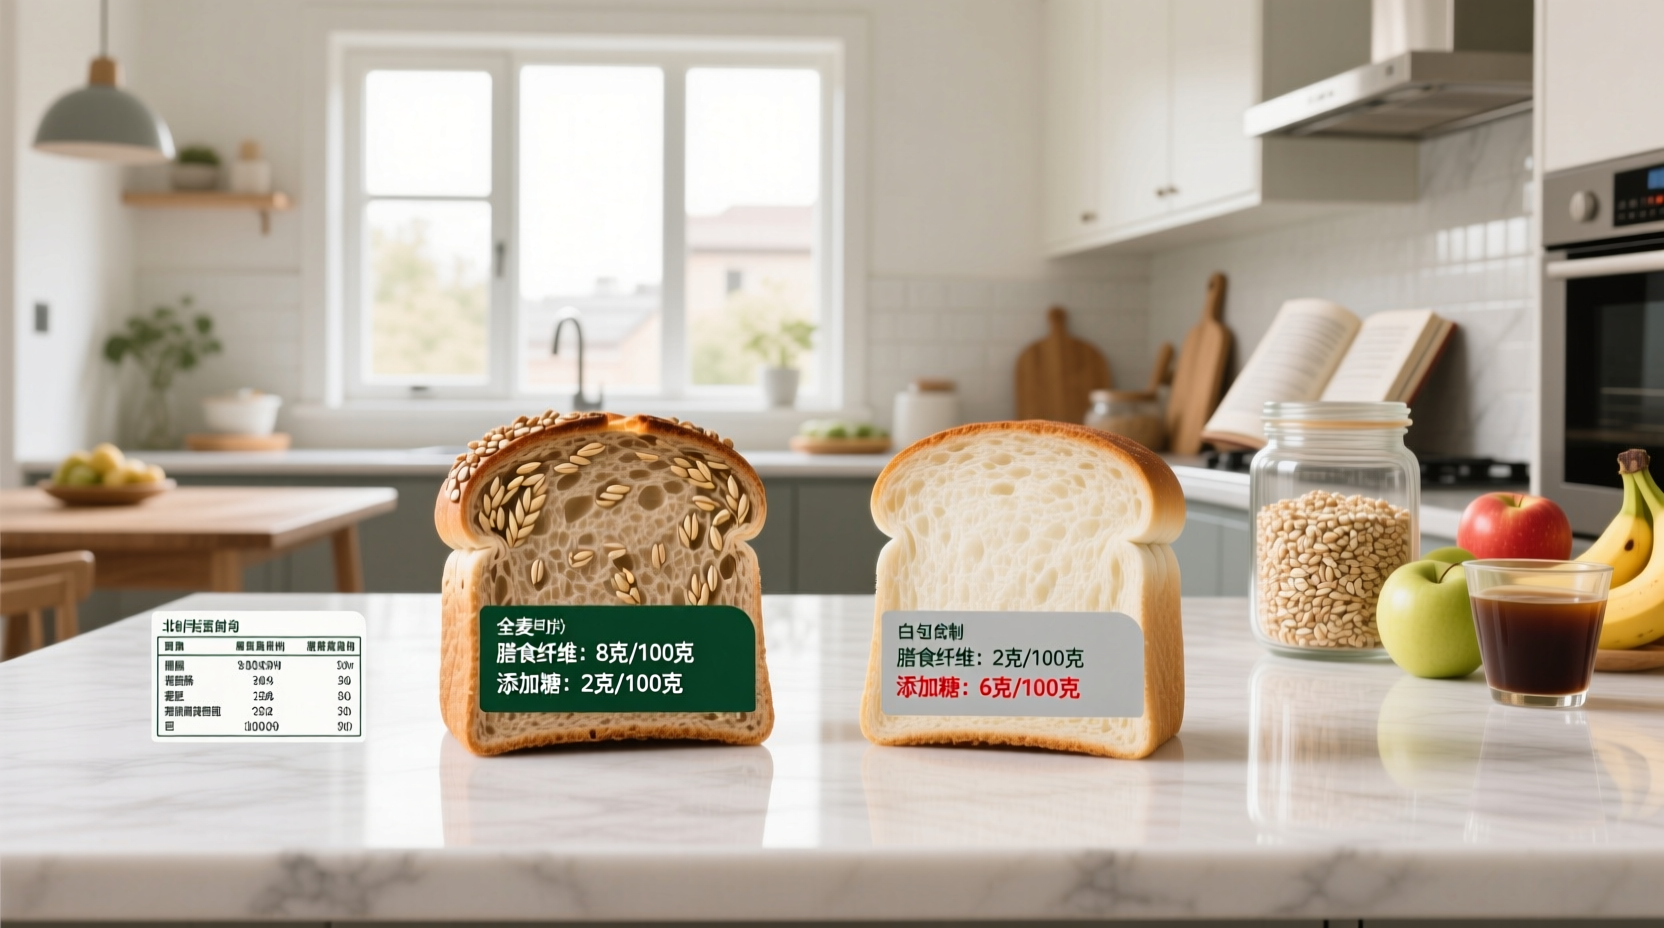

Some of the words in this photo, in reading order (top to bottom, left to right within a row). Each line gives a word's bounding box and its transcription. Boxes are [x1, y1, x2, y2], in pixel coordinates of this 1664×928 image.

[496, 640, 695, 665] 膳食纤维：8克/100克
[896, 646, 1085, 669] 膳食纤维：2克/100克
[496, 671, 684, 696] 添加糖：2克/100克
[896, 675, 1081, 700] 添加糖：6克/100克
